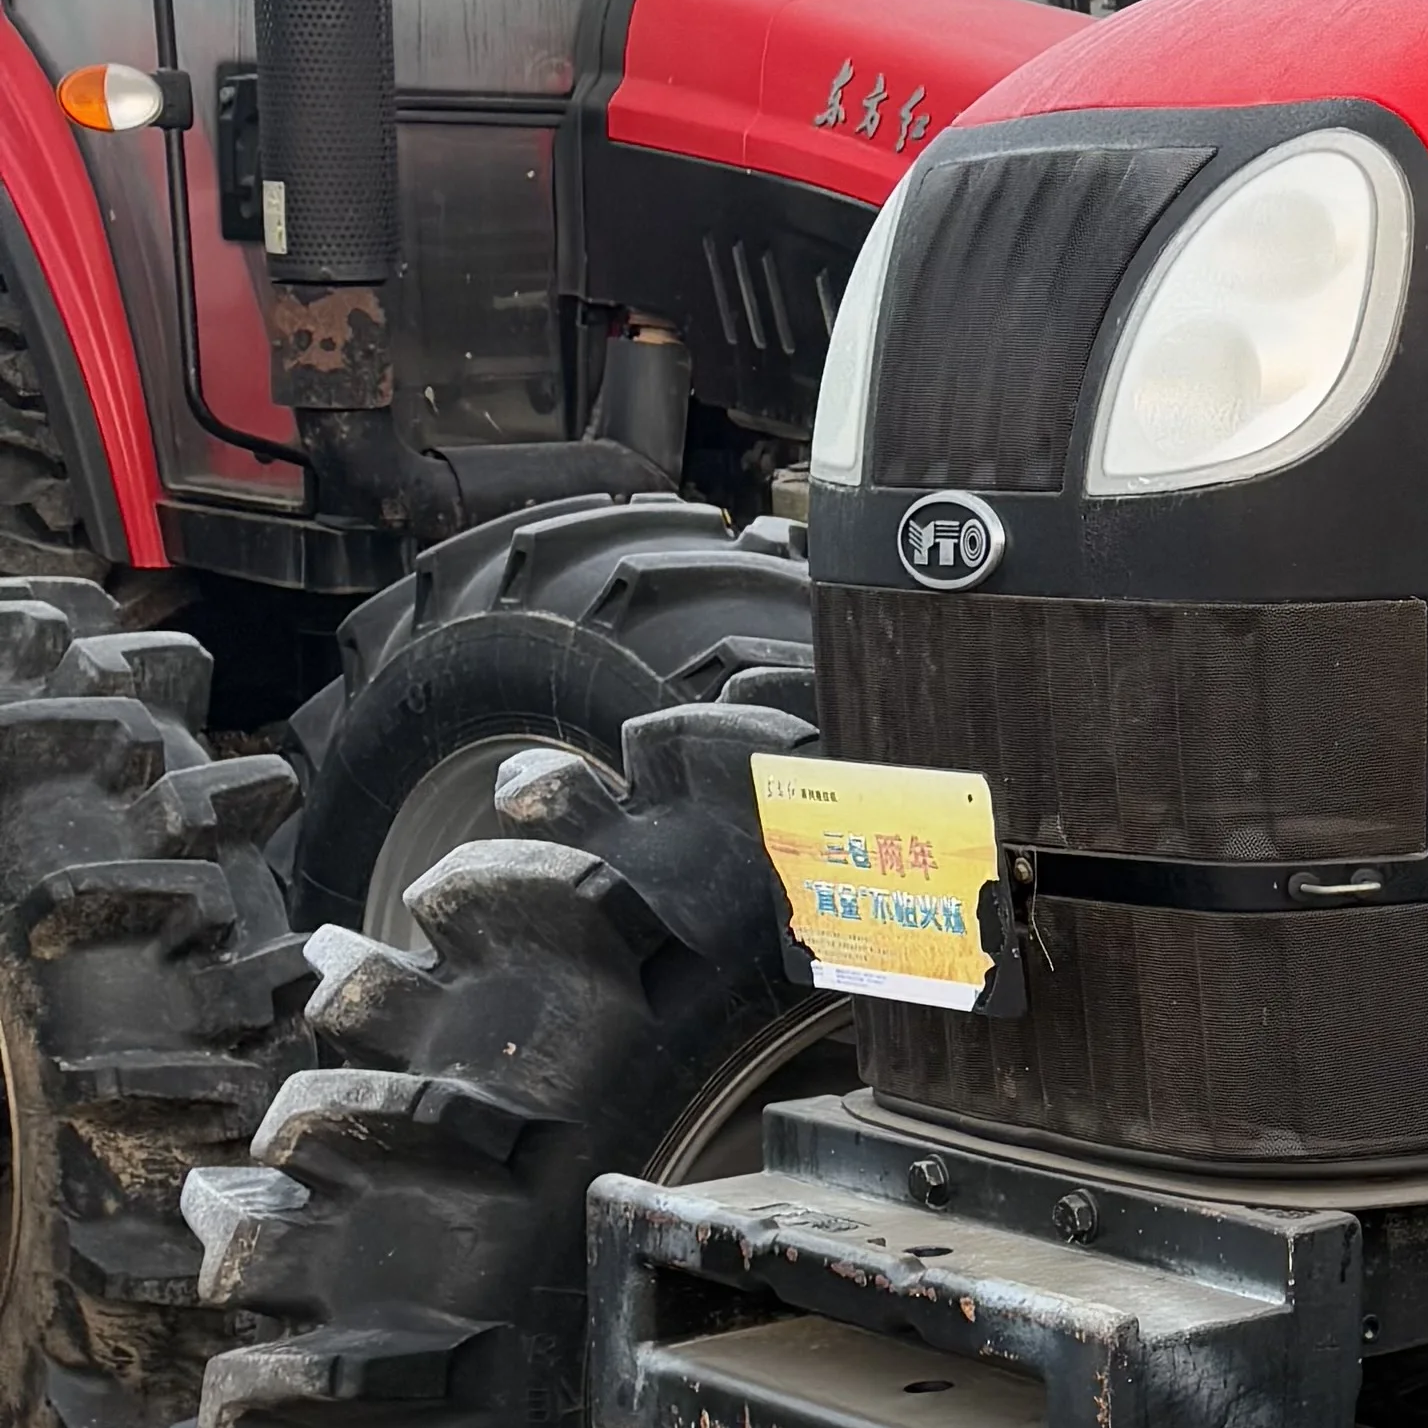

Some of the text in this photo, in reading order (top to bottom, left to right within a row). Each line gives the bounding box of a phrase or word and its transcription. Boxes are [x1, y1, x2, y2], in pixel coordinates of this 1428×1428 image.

[813, 56, 932, 153] 东方红
[908, 518, 987, 568] YTO
